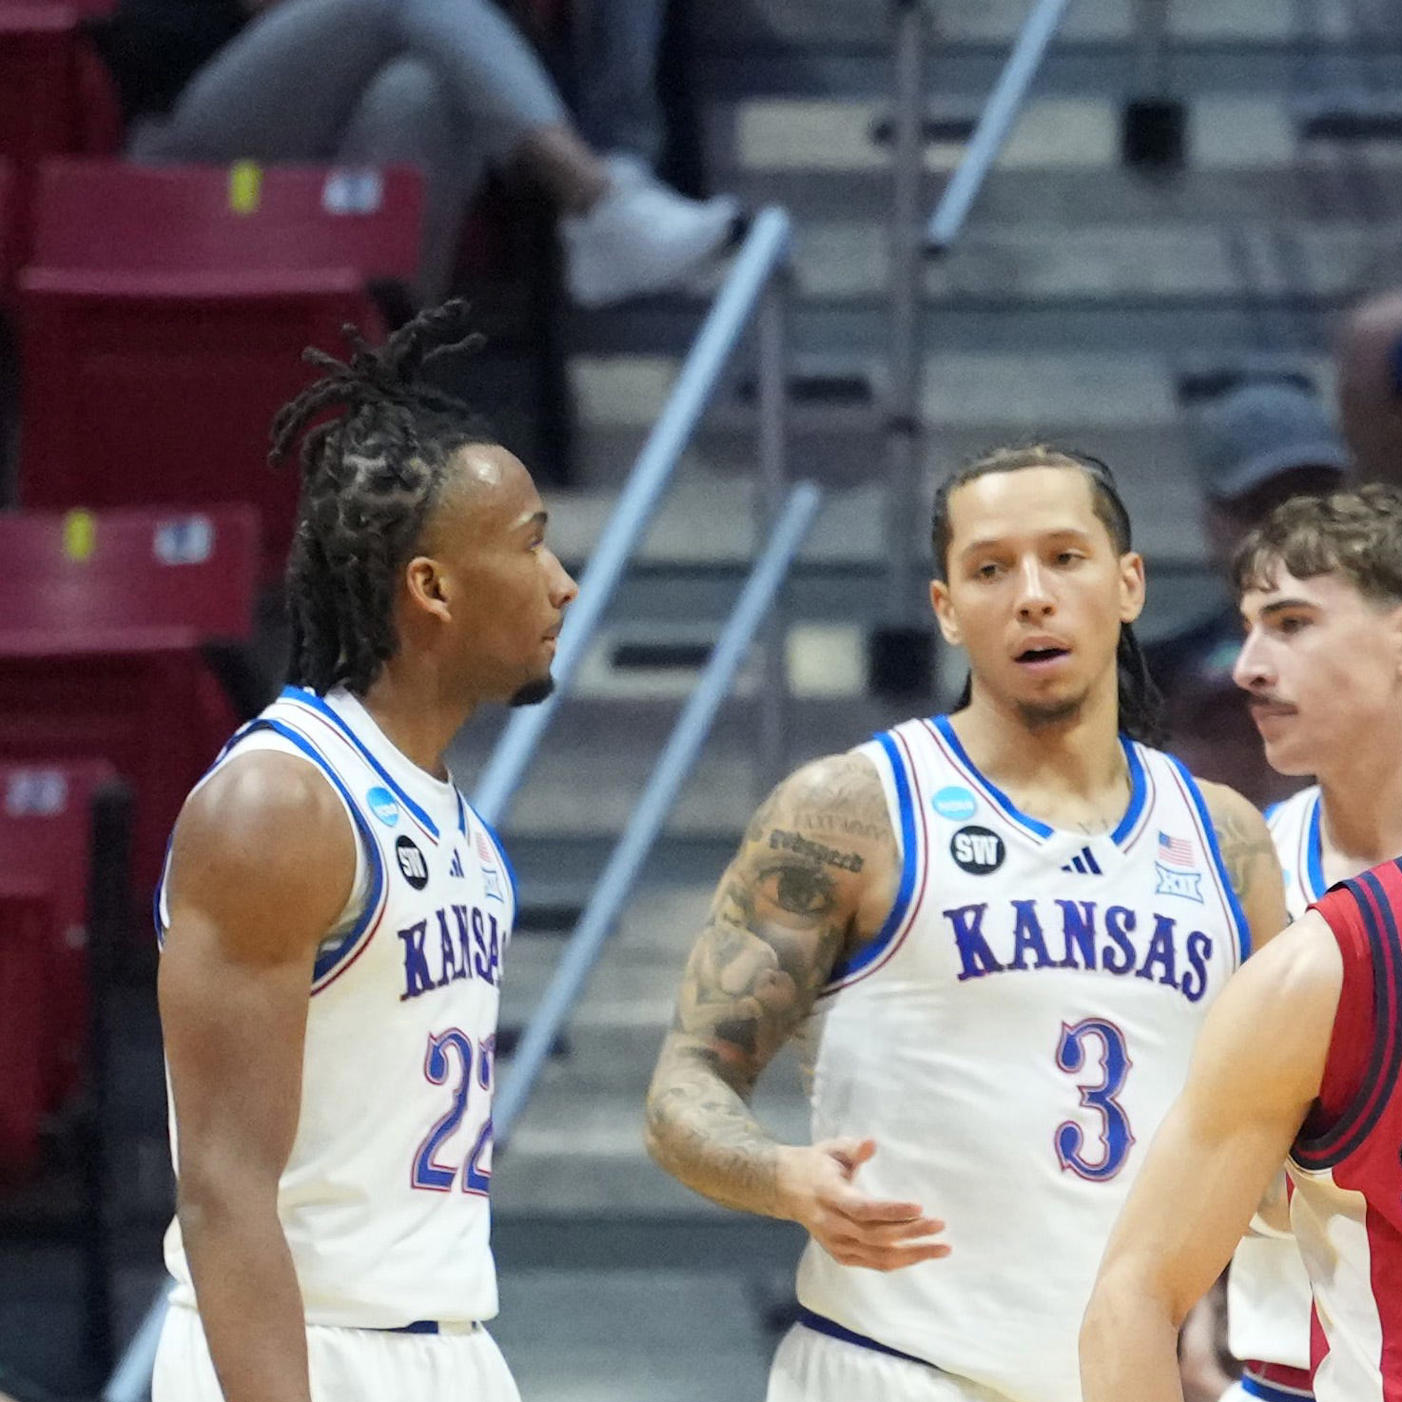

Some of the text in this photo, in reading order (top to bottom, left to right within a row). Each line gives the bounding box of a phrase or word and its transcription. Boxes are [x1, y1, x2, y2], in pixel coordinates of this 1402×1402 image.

[955, 833, 1000, 866] SW
[397, 904, 507, 1001] KANSA
[942, 899, 1213, 1002] KANSAS
[1055, 1017, 1136, 1182] 3
